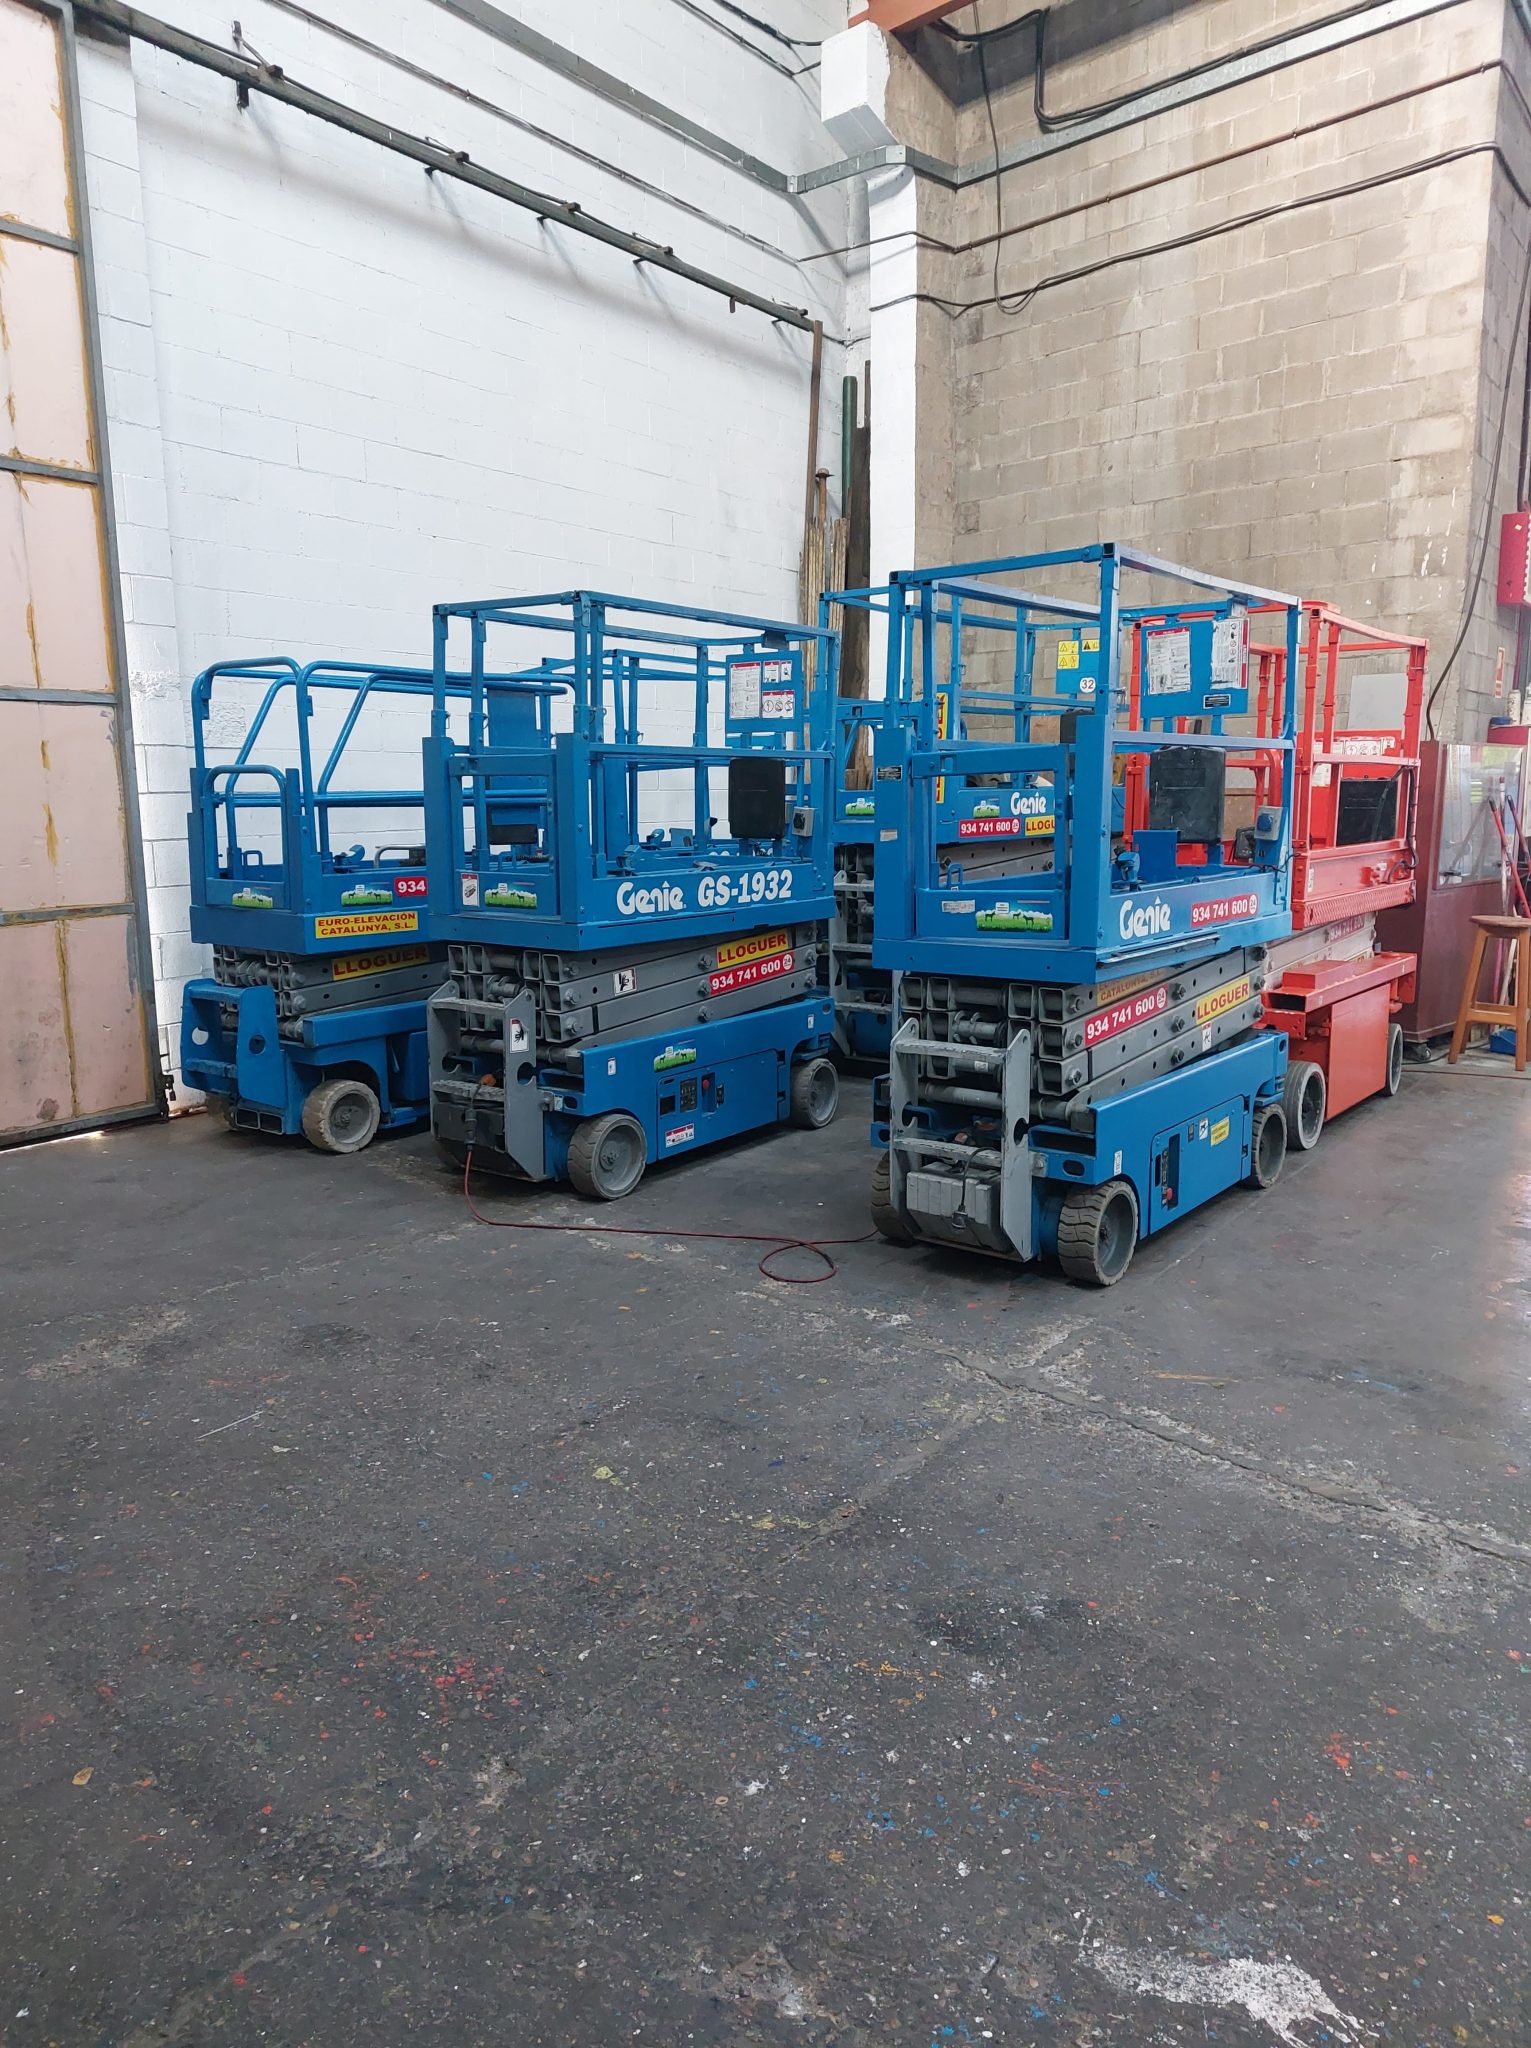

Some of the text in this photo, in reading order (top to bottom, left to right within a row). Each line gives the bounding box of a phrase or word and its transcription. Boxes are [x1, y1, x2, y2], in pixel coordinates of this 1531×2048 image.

[1081, 679, 1094, 690] 32
[1010, 792, 1046, 816] Genie
[961, 823, 976, 834] 934
[979, 822, 993, 833] 741
[996, 821, 1010, 832] 600
[398, 880, 426, 893] 934
[617, 869, 793, 915] Genie GS-1932
[318, 912, 415, 926] EURO-ELEVACIÓN
[1119, 895, 1171, 940] Genie
[1192, 905, 1210, 923] 934
[1213, 902, 1229, 918] 741
[1232, 899, 1248, 915] 600
[321, 923, 391, 936] CATALUNYA,
[333, 945, 427, 976] LLOGUER
[718, 933, 787, 964] LLOGUER
[711, 971, 735, 990] 934
[737, 968, 757, 983] 741
[761, 960, 781, 975] 600
[1197, 982, 1249, 1020] LLOGUER
[1086, 1016, 1110, 1040] 934
[1112, 1006, 1132, 1027] 741
[1135, 995, 1155, 1016] 600
